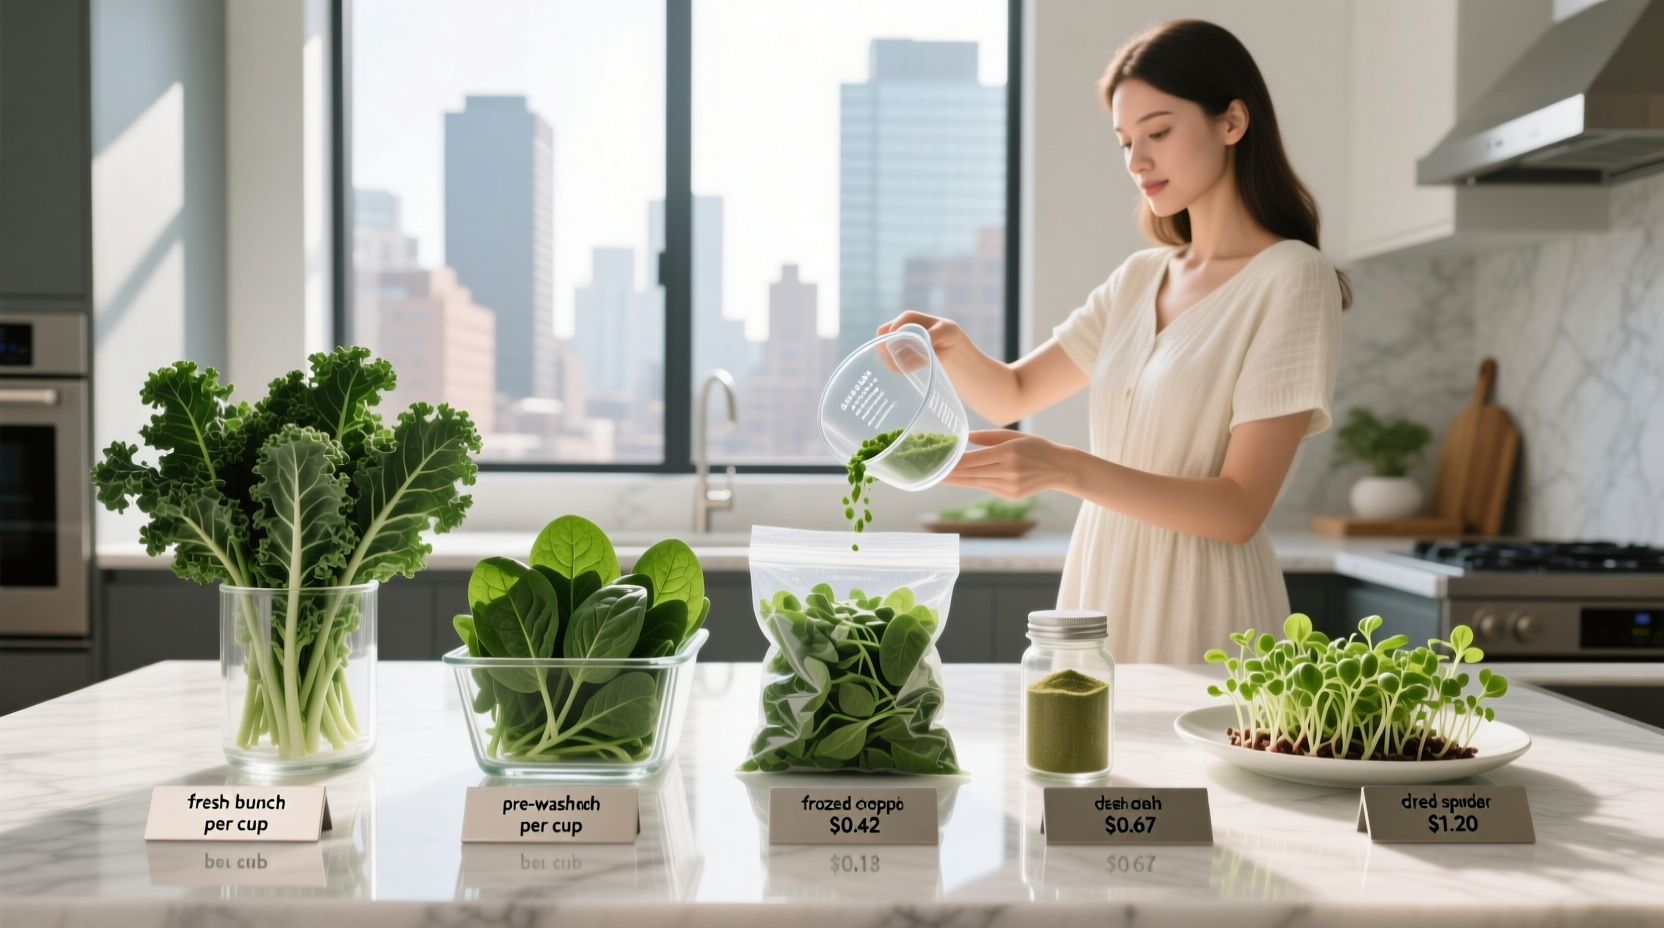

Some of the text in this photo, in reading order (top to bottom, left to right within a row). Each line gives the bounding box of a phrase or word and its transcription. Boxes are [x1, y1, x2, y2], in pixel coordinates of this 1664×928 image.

[187, 793, 286, 810] fresh bunch
[204, 819, 269, 836] per cup
[520, 821, 583, 837] per cup
[829, 816, 881, 836] $0.42
[1105, 815, 1157, 836] $0.67
[1428, 814, 1479, 834] $1.20
